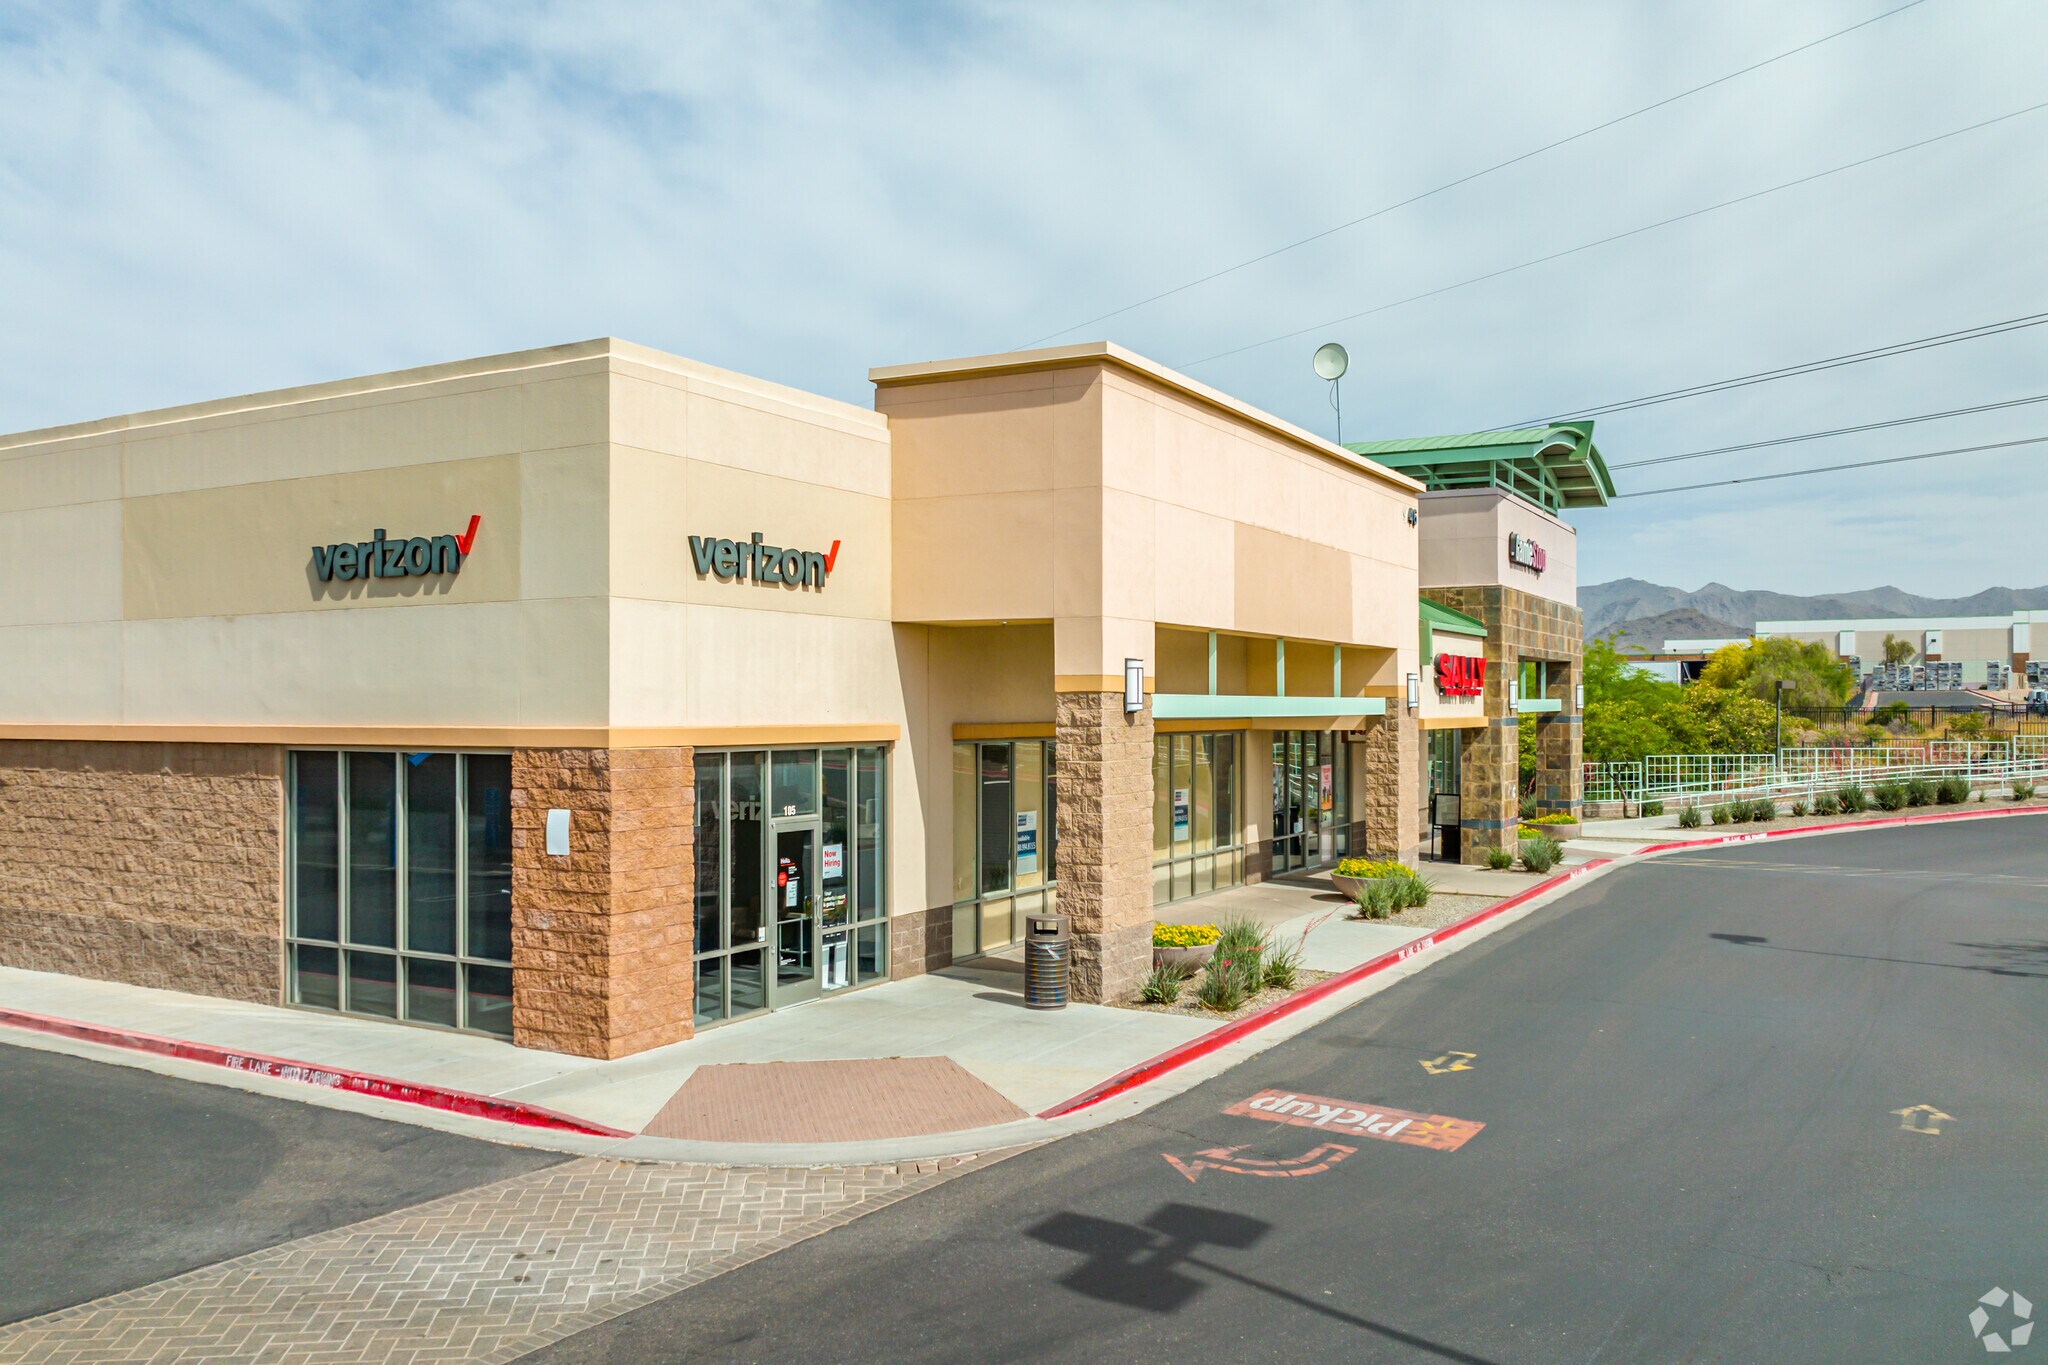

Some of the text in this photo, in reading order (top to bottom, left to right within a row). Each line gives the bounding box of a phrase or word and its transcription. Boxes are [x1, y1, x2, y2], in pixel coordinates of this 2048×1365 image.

[312, 529, 461, 582] verizon
[688, 532, 826, 588] verizon
[1436, 653, 1488, 688] SALLY
[783, 805, 796, 816] 105
[824, 859, 840, 868] Hiring
[225, 1055, 244, 1070] FIRE
[249, 1059, 272, 1075] LANE
[1249, 1095, 1413, 1137] Pickup
